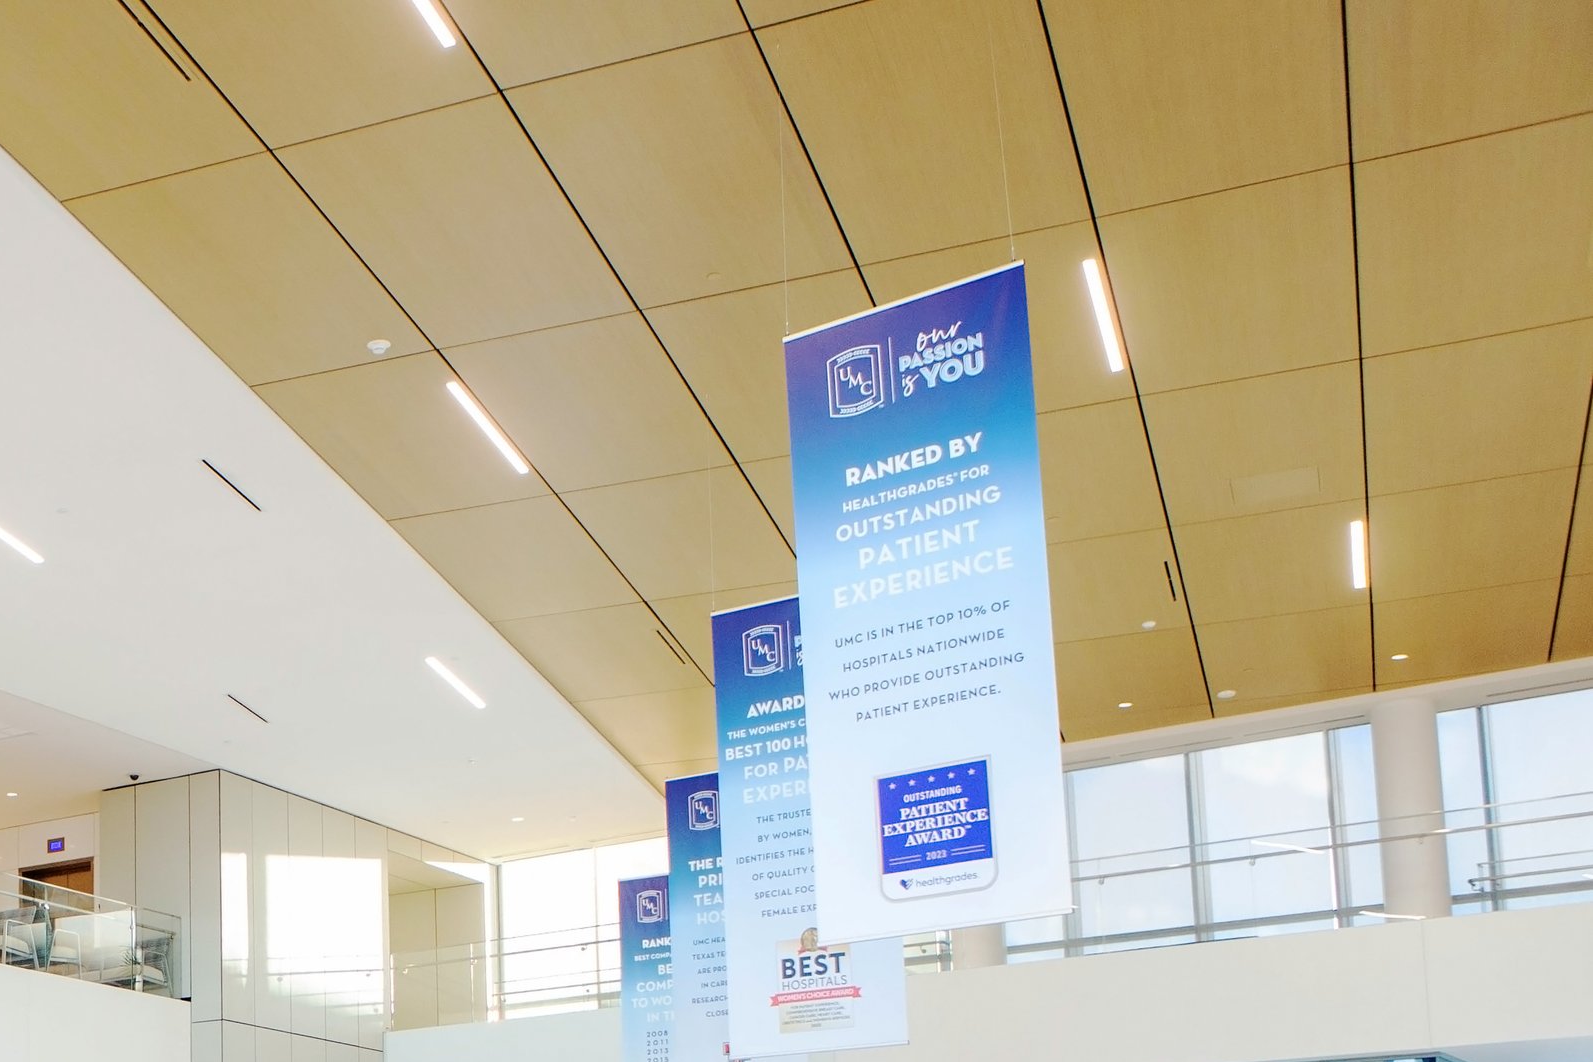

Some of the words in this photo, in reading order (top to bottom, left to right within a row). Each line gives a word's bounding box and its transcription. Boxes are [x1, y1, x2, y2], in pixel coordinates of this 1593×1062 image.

[916, 320, 962, 352] our
[899, 332, 984, 372] PASSION
[838, 365, 873, 396] UMC
[902, 375, 919, 397] is
[918, 350, 985, 388] YOU
[845, 444, 943, 487] RANKED
[949, 432, 983, 459] BY
[960, 464, 989, 482] FOR
[835, 485, 1002, 542] OUTSTANDING
[859, 519, 980, 570] PATIENT
[833, 546, 1014, 609] EXPERIENCE
[835, 633, 863, 648] UMC
[867, 629, 878, 641] IS
[881, 626, 894, 638] IN
[898, 619, 923, 634] THE
[927, 612, 954, 628] TOP
[958, 605, 986, 621] 10%
[991, 600, 1010, 614] OF
[751, 638, 776, 662] UMC
[843, 648, 913, 673] HOSPITALS
[917, 628, 1005, 660] NATIONWIDE
[828, 686, 860, 701] WHO
[864, 673, 921, 694] PROVIDE
[925, 651, 1025, 682] OUTSTANDING
[856, 702, 909, 722] PATIENT
[913, 684, 1002, 710] EXPERIENCE.
[727, 729, 747, 740] THE
[749, 720, 796, 736] WOMEN'S
[725, 742, 763, 761] BEST
[767, 738, 791, 754] 100
[744, 762, 778, 781] FOR
[903, 785, 962, 802] OUTSTANDING
[756, 814, 774, 824] THE
[899, 797, 968, 821] PATIENT
[882, 808, 989, 837] EXPERIENCE
[757, 834, 769, 843] BY
[688, 858, 714, 872] THE
[736, 851, 785, 865] IDENTIFIES
[787, 848, 805, 857] THE
[926, 849, 947, 861] 2023
[752, 872, 764, 881] OF
[767, 866, 808, 880] QUALITY
[754, 888, 792, 900] SPECIAL
[761, 905, 798, 918] FEMALE
[693, 937, 710, 946] UMC
[651, 952, 671, 960] COMP
[692, 951, 714, 961] TEXAS
[782, 952, 845, 979] BEST
[697, 967, 711, 975] ARE
[782, 975, 847, 991] HOSPITALS
[631, 997, 648, 1008] TO
